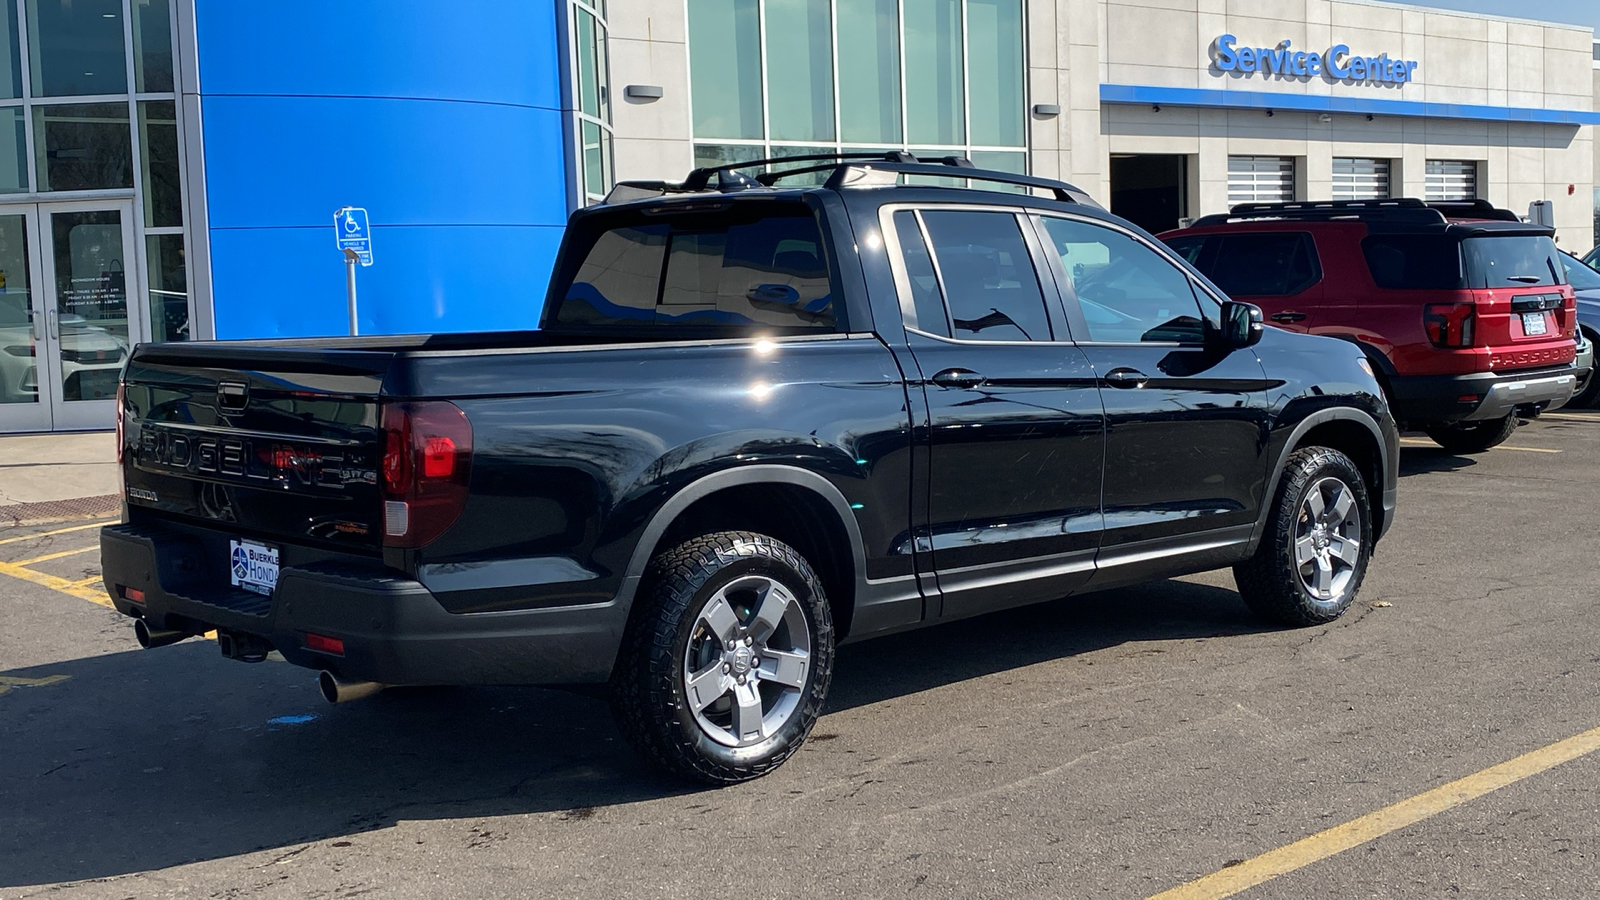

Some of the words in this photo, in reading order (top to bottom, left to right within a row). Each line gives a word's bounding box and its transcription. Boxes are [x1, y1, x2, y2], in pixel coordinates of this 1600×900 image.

[1216, 33, 1321, 76] Service
[1325, 44, 1418, 83] Center
[1492, 347, 1576, 366] PASSPORT
[139, 427, 345, 489] RIDGELINE
[129, 487, 158, 502] HONDA
[249, 549, 279, 566] BUERKLE
